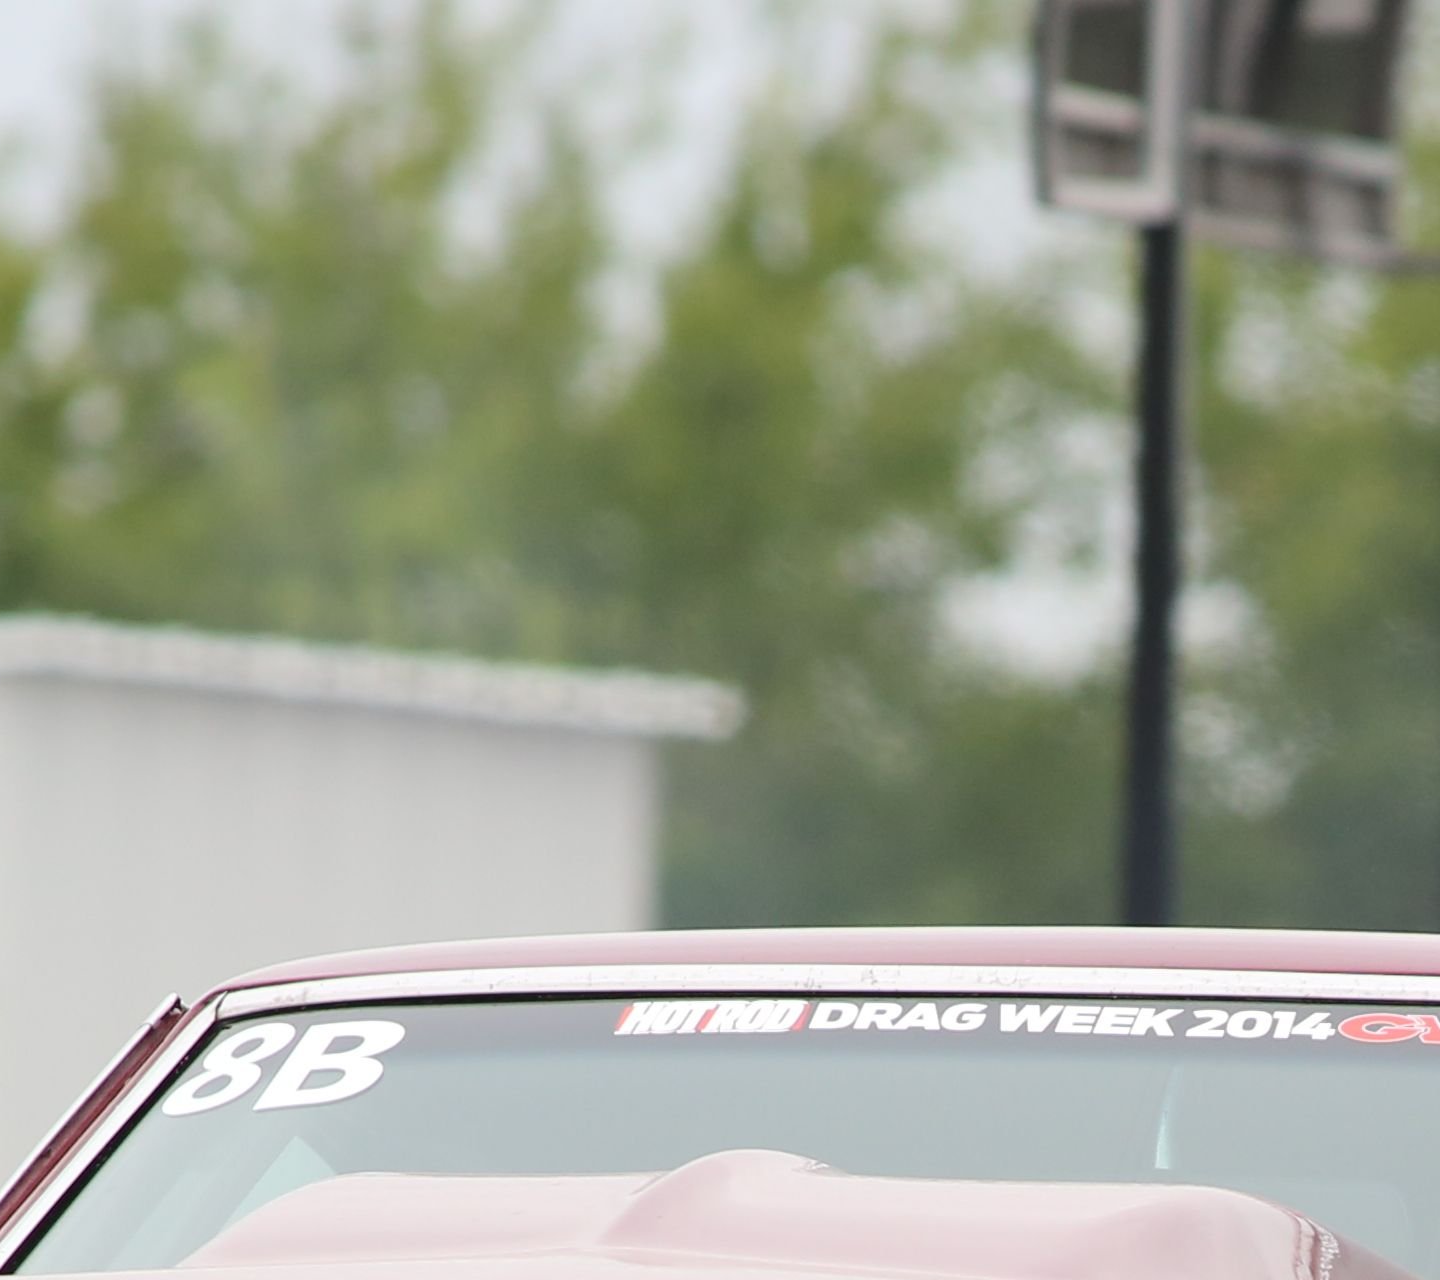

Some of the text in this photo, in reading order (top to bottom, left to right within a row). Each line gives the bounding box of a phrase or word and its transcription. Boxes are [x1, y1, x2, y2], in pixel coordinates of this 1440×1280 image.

[809, 1003, 987, 1031] DRAG
[1000, 1004, 1184, 1037] WEEK
[1186, 1010, 1335, 1040] 2014
[161, 1020, 406, 1117] 8B
